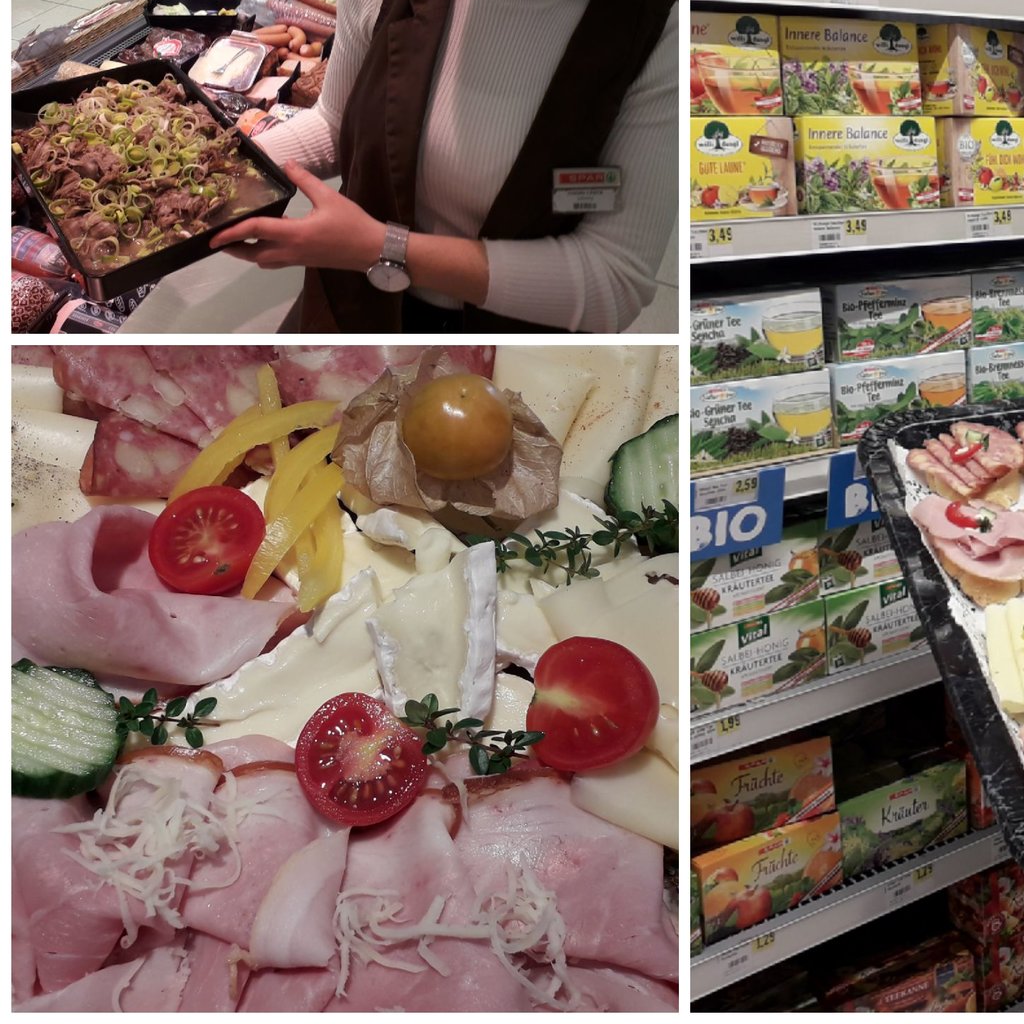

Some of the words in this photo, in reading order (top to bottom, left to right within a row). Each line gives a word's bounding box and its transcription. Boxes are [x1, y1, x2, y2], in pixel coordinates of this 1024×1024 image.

[785, 27, 822, 41] Innere
[824, 28, 869, 43] Balance
[808, 127, 843, 140] Innere
[846, 126, 888, 140] Balance
[959, 141, 975, 150] BIO
[846, 219, 867, 233] 3,49
[708, 227, 733, 243] 3,49
[842, 298, 907, 313] Bio-Pfefferminz
[998, 298, 1011, 307] Tee
[726, 316, 742, 328] Tee
[868, 310, 883, 320] Tee
[841, 378, 905, 396] Bio-Pfefferminz
[737, 400, 752, 411] Tee
[866, 392, 880, 403] Tee
[704, 414, 736, 428] Sencha
[735, 477, 758, 493] 2,59
[690, 505, 768, 554] BIO
[712, 558, 782, 584] SALBEI-HONIG
[721, 573, 775, 594] KRÄUTERTEE
[881, 586, 908, 607] Vital
[740, 624, 768, 645] Vital
[721, 637, 790, 667] SALBEI-HONIG
[730, 653, 783, 676] KRÄUTERTEE
[730, 767, 784, 797] Früchte
[881, 799, 931, 827] Kräuter
[751, 848, 800, 882] Früchte
[884, 981, 931, 1005] TEEKANNE
